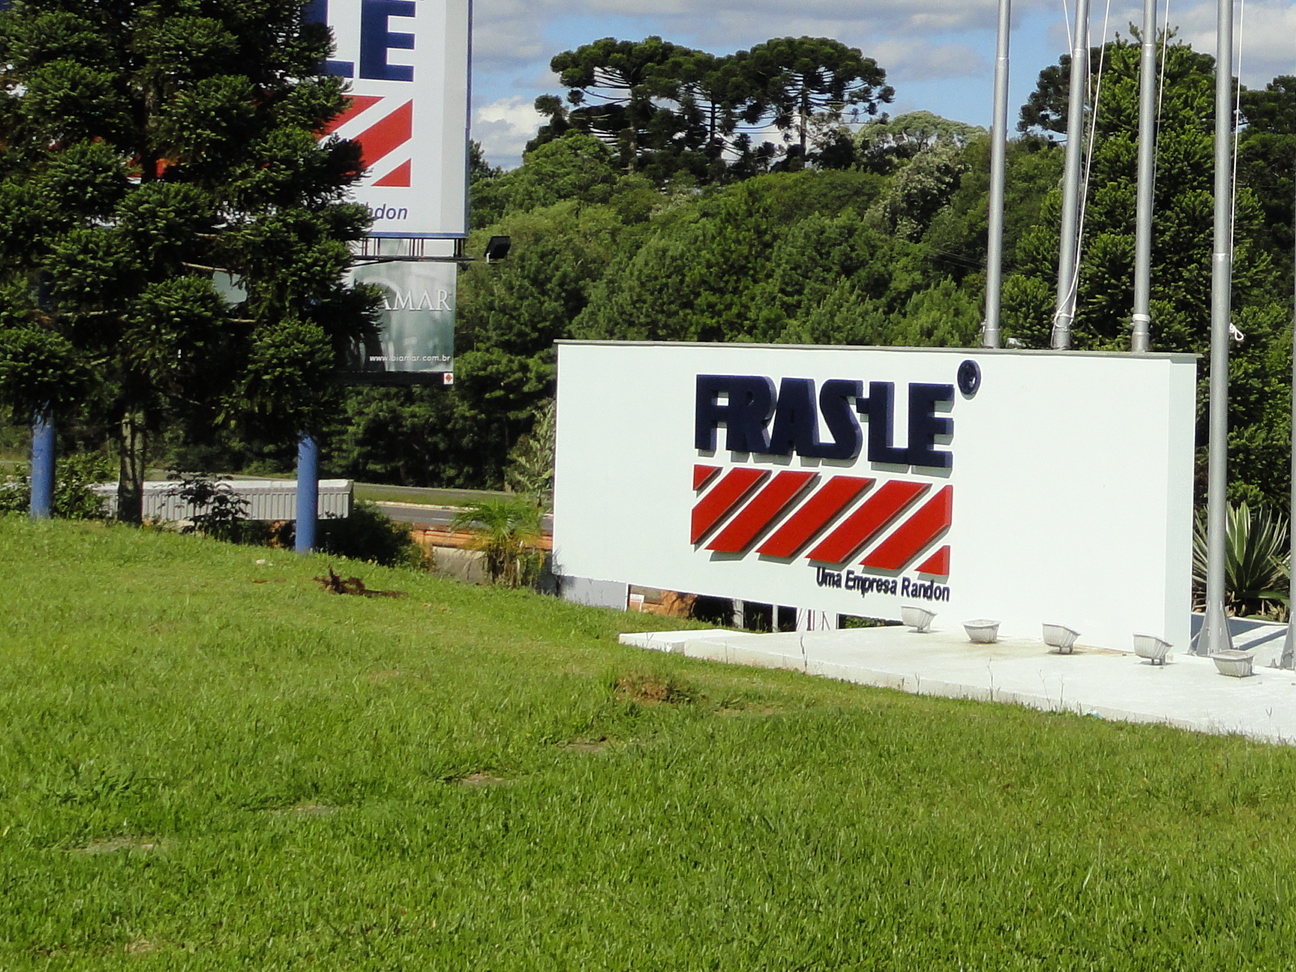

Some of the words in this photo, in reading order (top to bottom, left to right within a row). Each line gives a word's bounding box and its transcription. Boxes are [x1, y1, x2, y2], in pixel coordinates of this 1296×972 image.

[369, 354, 451, 362] www.biamar.com.br
[816, 566, 842, 588] Uma
[845, 569, 897, 598] Empresa
[901, 576, 951, 602] Randon
